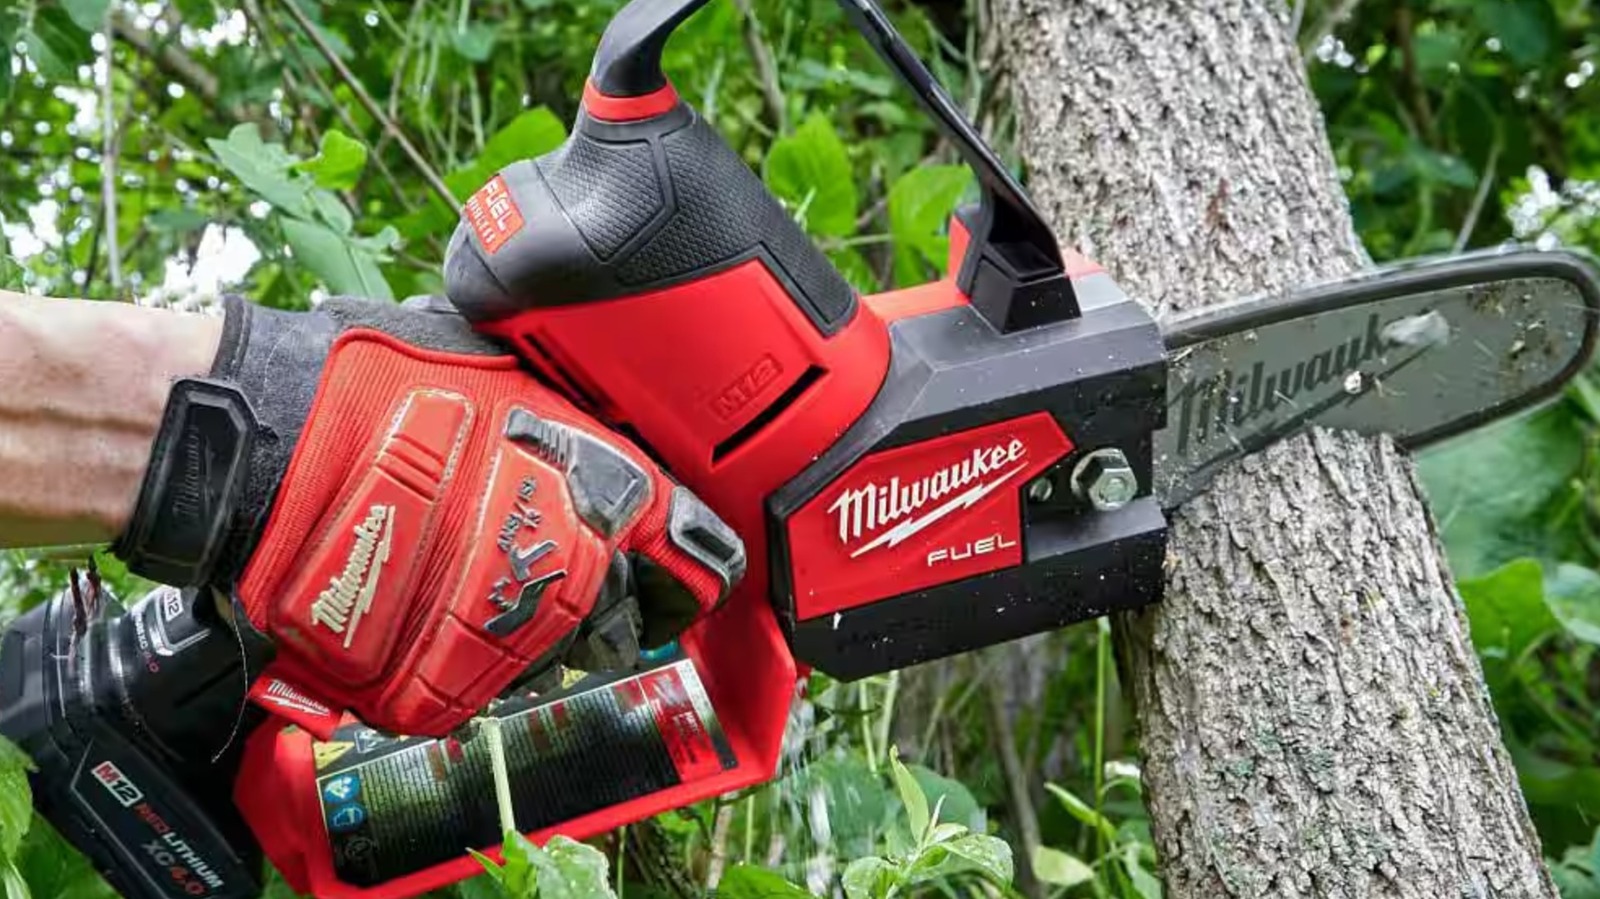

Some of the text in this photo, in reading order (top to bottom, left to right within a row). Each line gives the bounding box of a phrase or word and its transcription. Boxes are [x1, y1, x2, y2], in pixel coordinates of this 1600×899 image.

[485, 181, 513, 232] FUEL
[1168, 313, 1400, 455] Milwauk
[827, 438, 1027, 545] Milwaukee
[312, 505, 388, 633] Milwaukee
[928, 533, 1017, 567] FUEL
[267, 679, 330, 713] Milwaukee
[95, 763, 138, 803] M12
